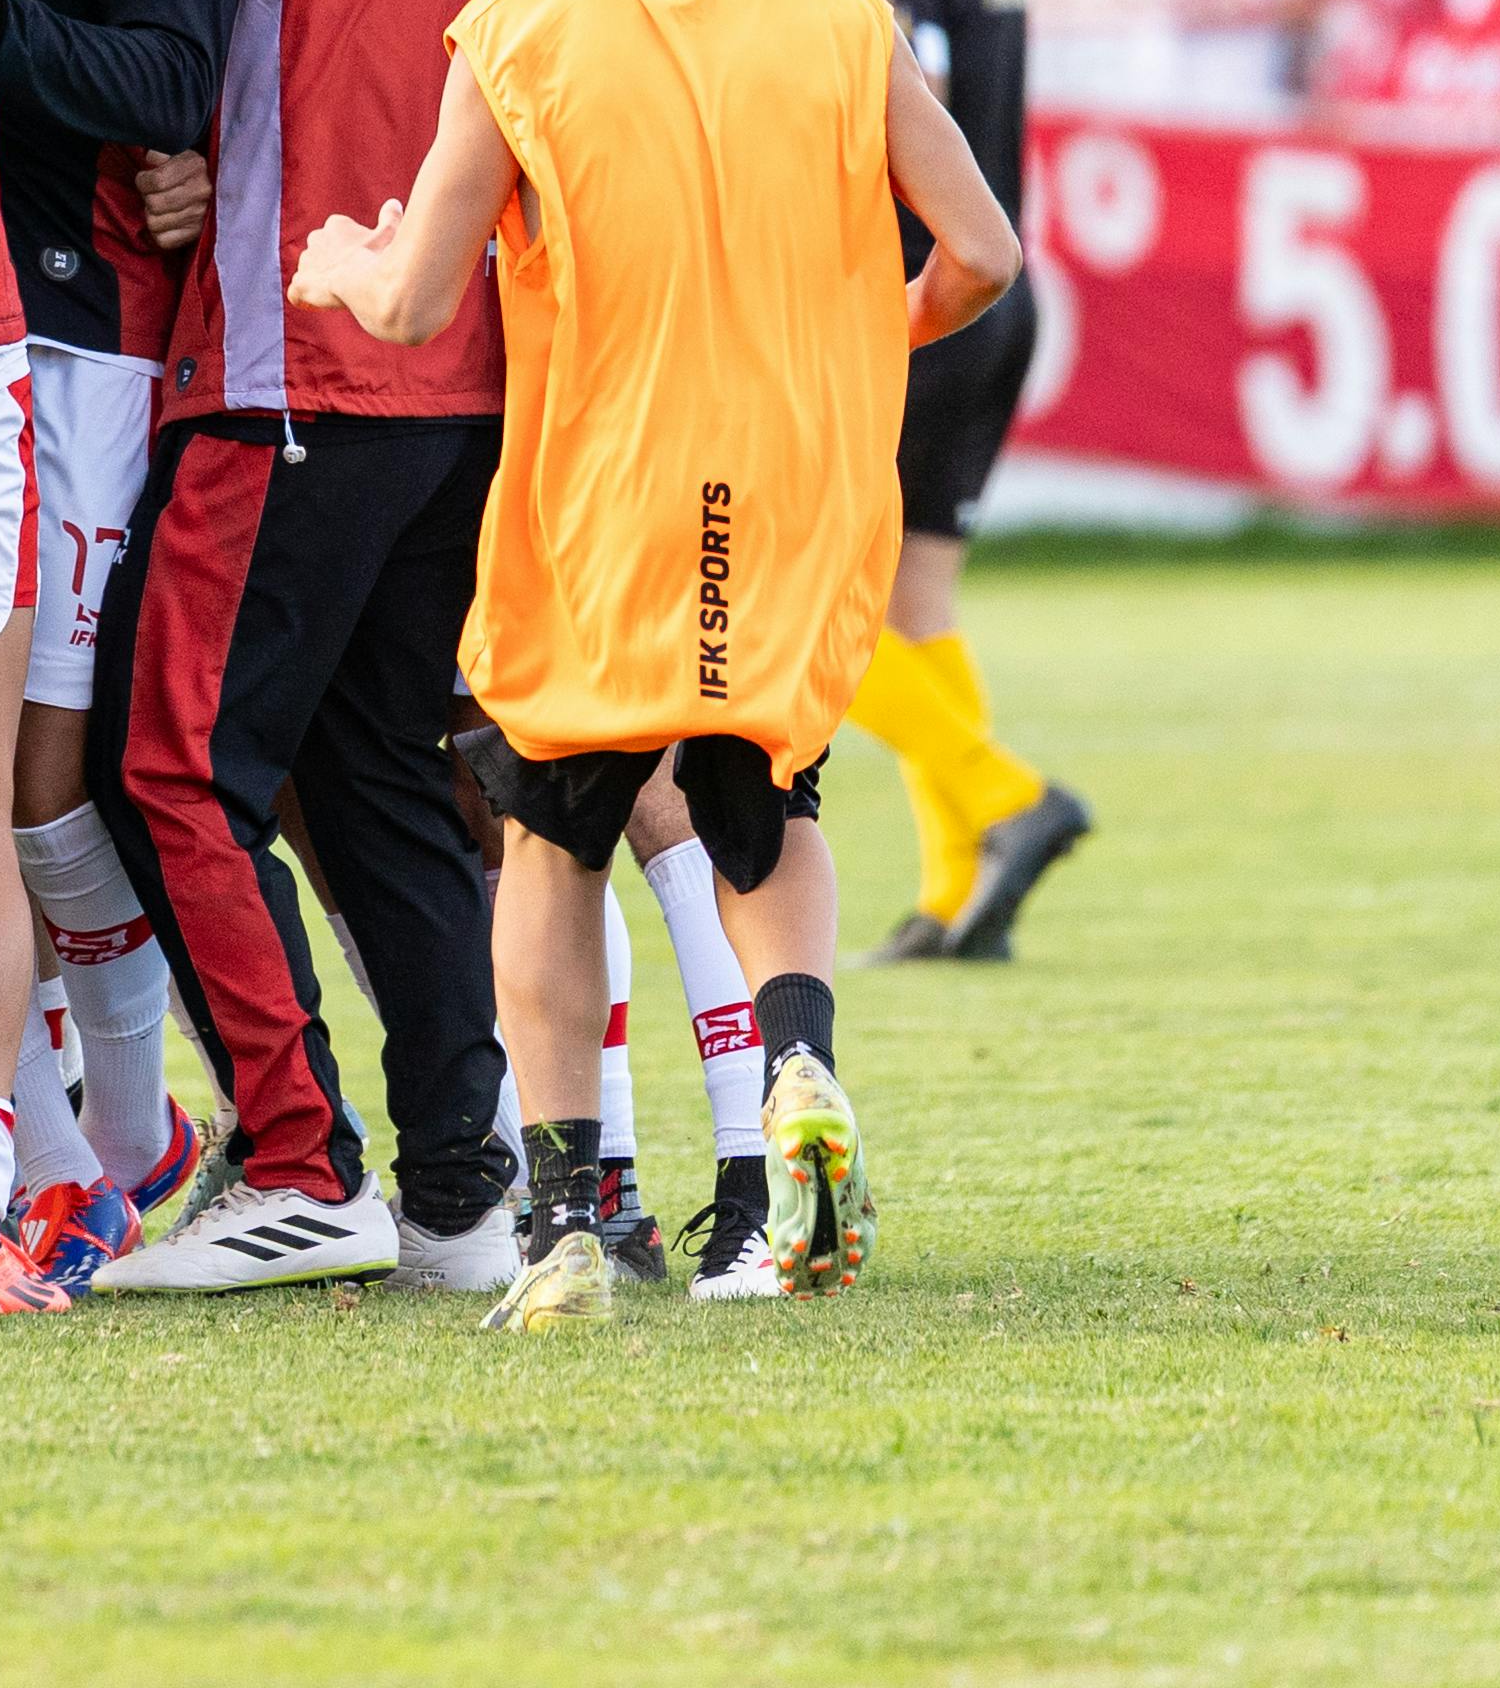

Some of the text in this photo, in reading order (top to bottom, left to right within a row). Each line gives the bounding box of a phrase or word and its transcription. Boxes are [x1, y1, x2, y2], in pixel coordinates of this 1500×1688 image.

[699, 481, 732, 700] IFK SPORTS
[703, 1032, 753, 1057] IFK
